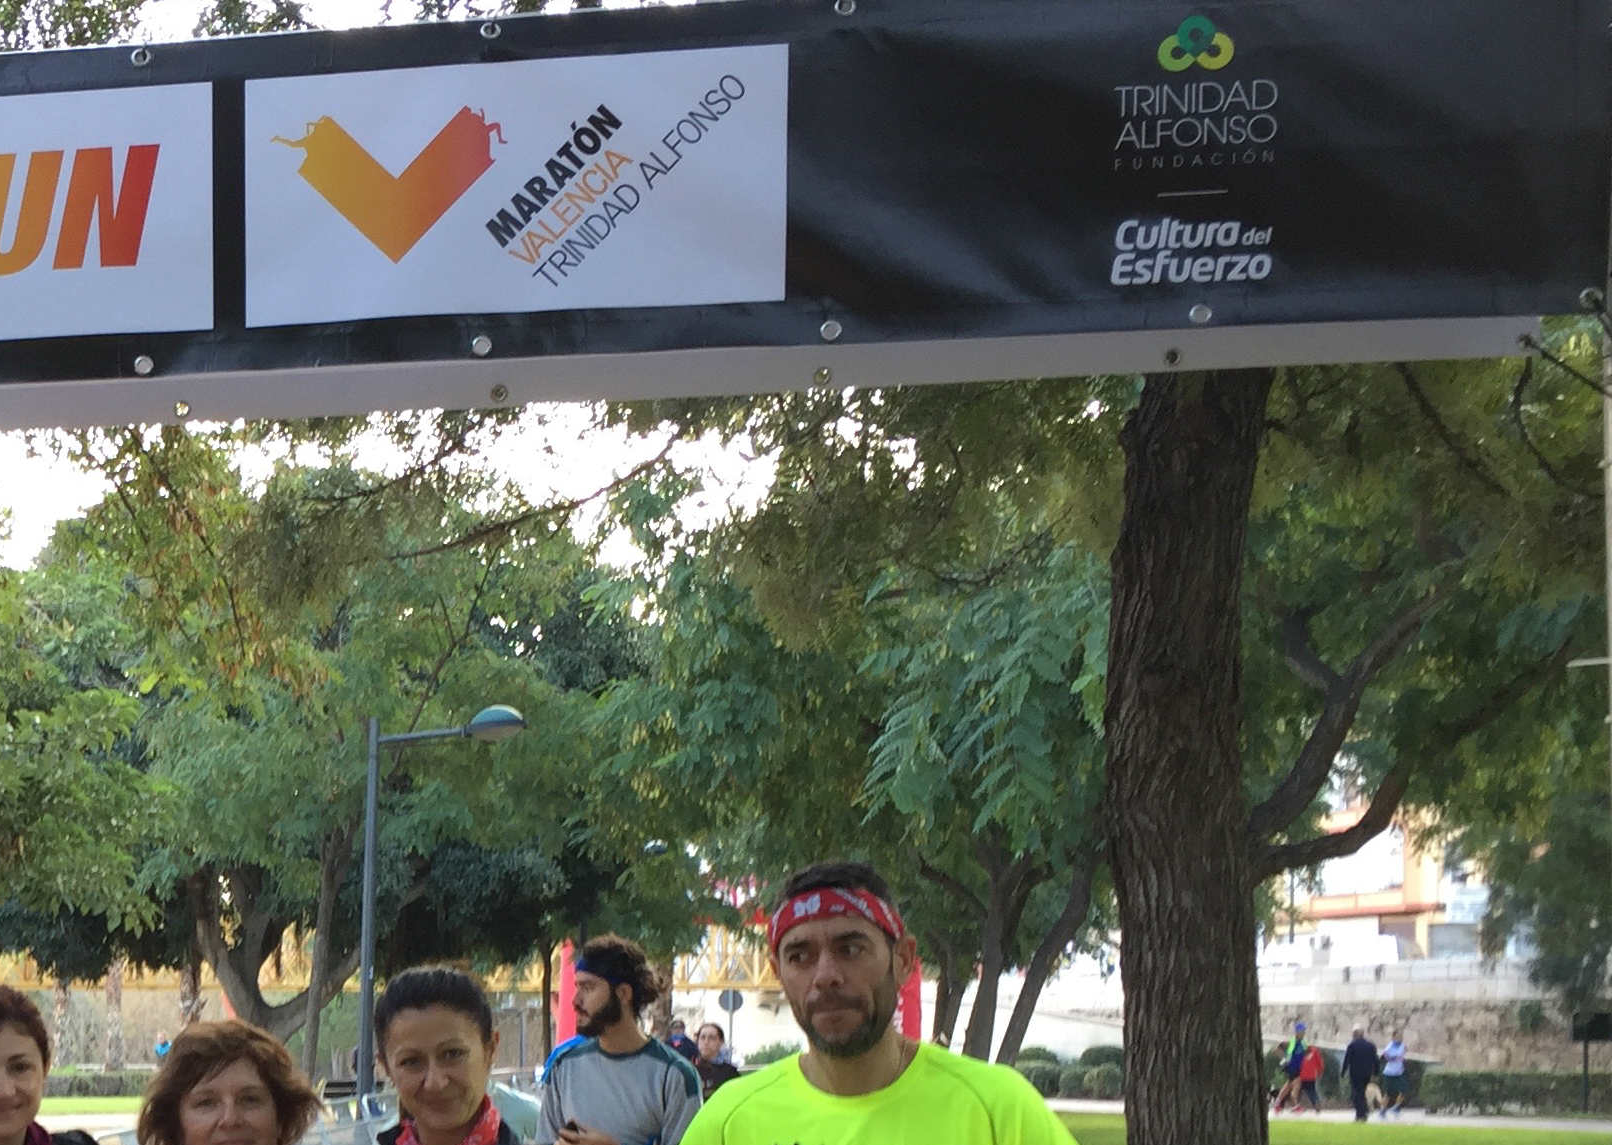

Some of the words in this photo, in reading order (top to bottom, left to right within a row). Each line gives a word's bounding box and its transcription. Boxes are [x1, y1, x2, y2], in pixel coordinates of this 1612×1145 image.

[1114, 79, 1279, 118] TRINIDAD
[1114, 114, 1278, 151] ALFONSO
[484, 103, 624, 249] MARATÓN
[1114, 148, 1276, 172] FUNDACIÓN
[532, 183, 641, 288] TRINIDAD
[638, 73, 747, 190] ALFONSO
[508, 149, 635, 266] VALENCIA
[1115, 217, 1241, 252] Cultura
[1241, 227, 1273, 246] del
[1109, 250, 1273, 287] Esfuerzo
